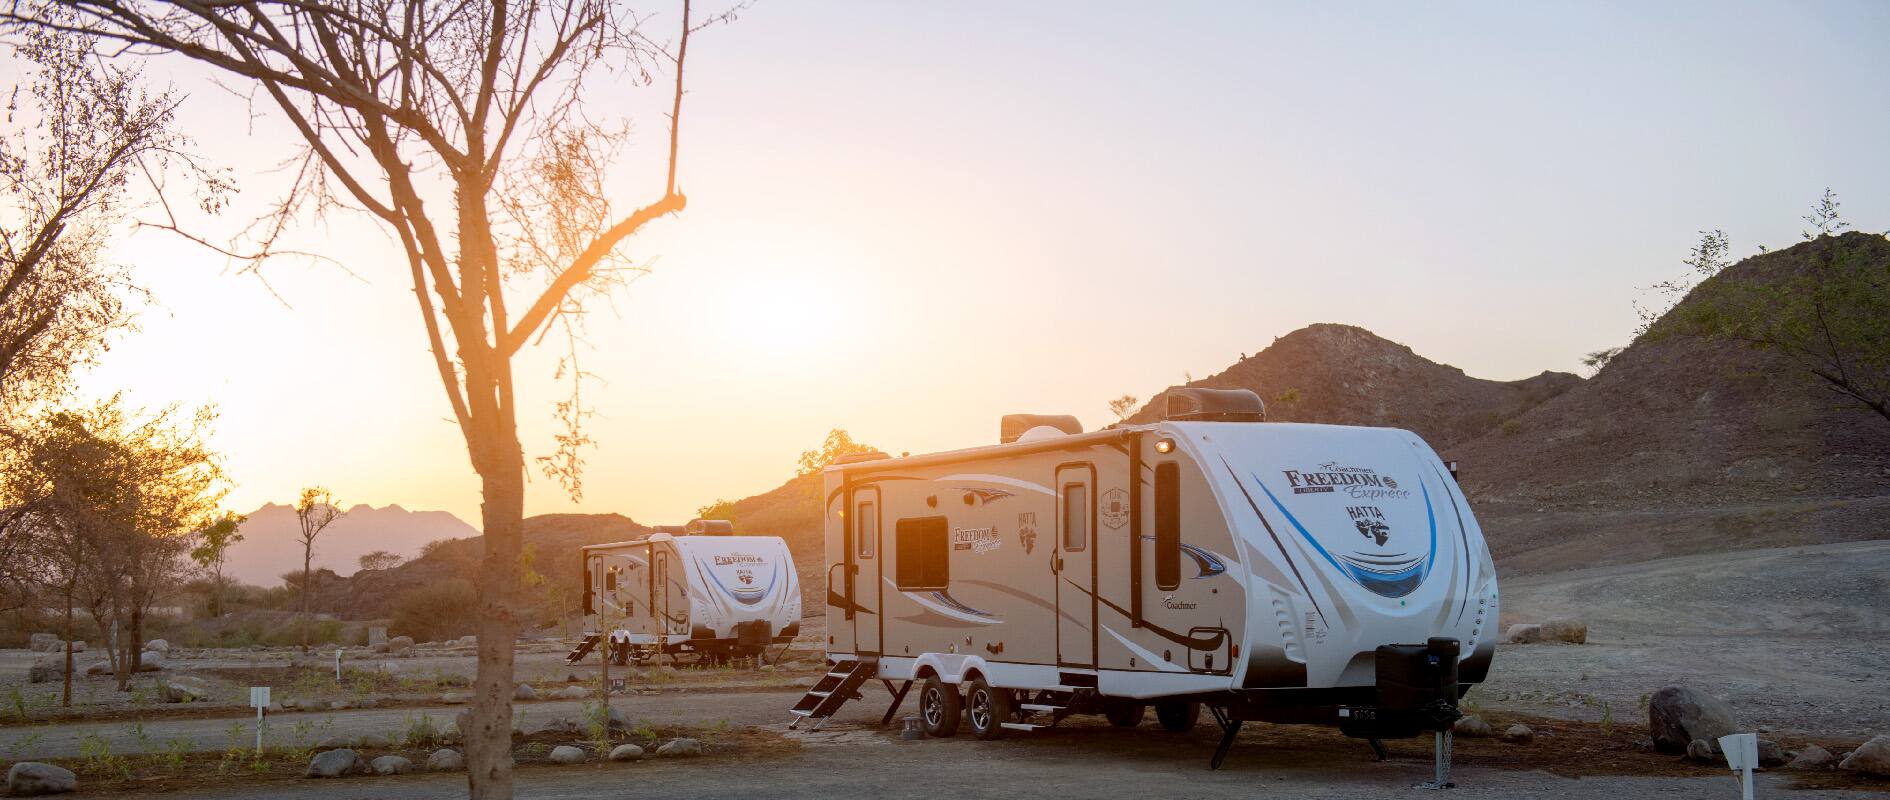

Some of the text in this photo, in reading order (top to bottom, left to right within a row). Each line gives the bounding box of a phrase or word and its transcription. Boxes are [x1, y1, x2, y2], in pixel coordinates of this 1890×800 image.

[1283, 470, 1384, 487] FREEDOM
[1343, 485, 1409, 500] Express
[1018, 511, 1037, 528] HATTA
[1346, 506, 1386, 521] HATTA
[954, 527, 990, 542] FREEDOM
